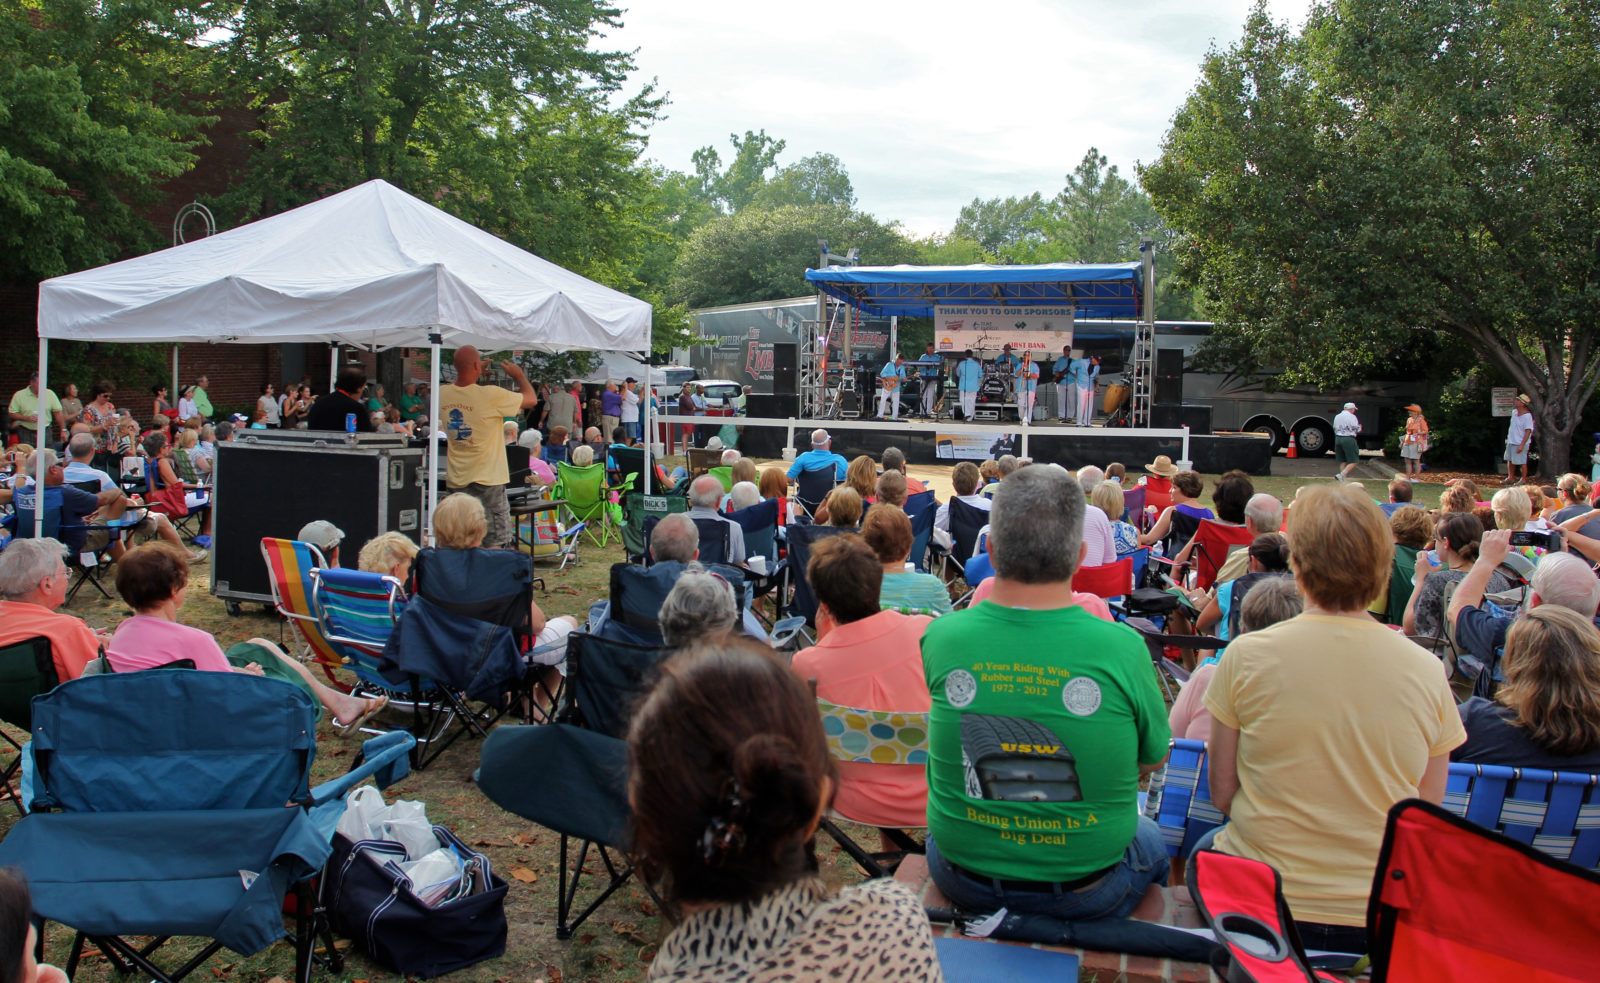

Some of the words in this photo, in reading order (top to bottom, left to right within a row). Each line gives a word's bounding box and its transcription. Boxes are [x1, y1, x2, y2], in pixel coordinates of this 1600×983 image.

[939, 307, 968, 315] THANK
[970, 307, 988, 315] YOU
[1024, 308, 1071, 316] SPONSORS
[972, 663, 984, 671] 40
[985, 662, 1011, 671] Years
[1013, 663, 1044, 676] Riding
[1047, 666, 1070, 678] With
[981, 673, 1013, 682] Rubber
[1016, 674, 1033, 683] and
[1036, 676, 1060, 687] Steel
[992, 684, 1014, 693] 1972
[1024, 686, 1048, 696] 2012
[1001, 743, 1060, 754] USW
[966, 807, 1010, 829] Being
[1014, 816, 1062, 829] Union
[1067, 817, 1081, 829] Is
[1085, 812, 1099, 826] A
[1000, 830, 1027, 845] Big
[1032, 832, 1067, 845] Deal
